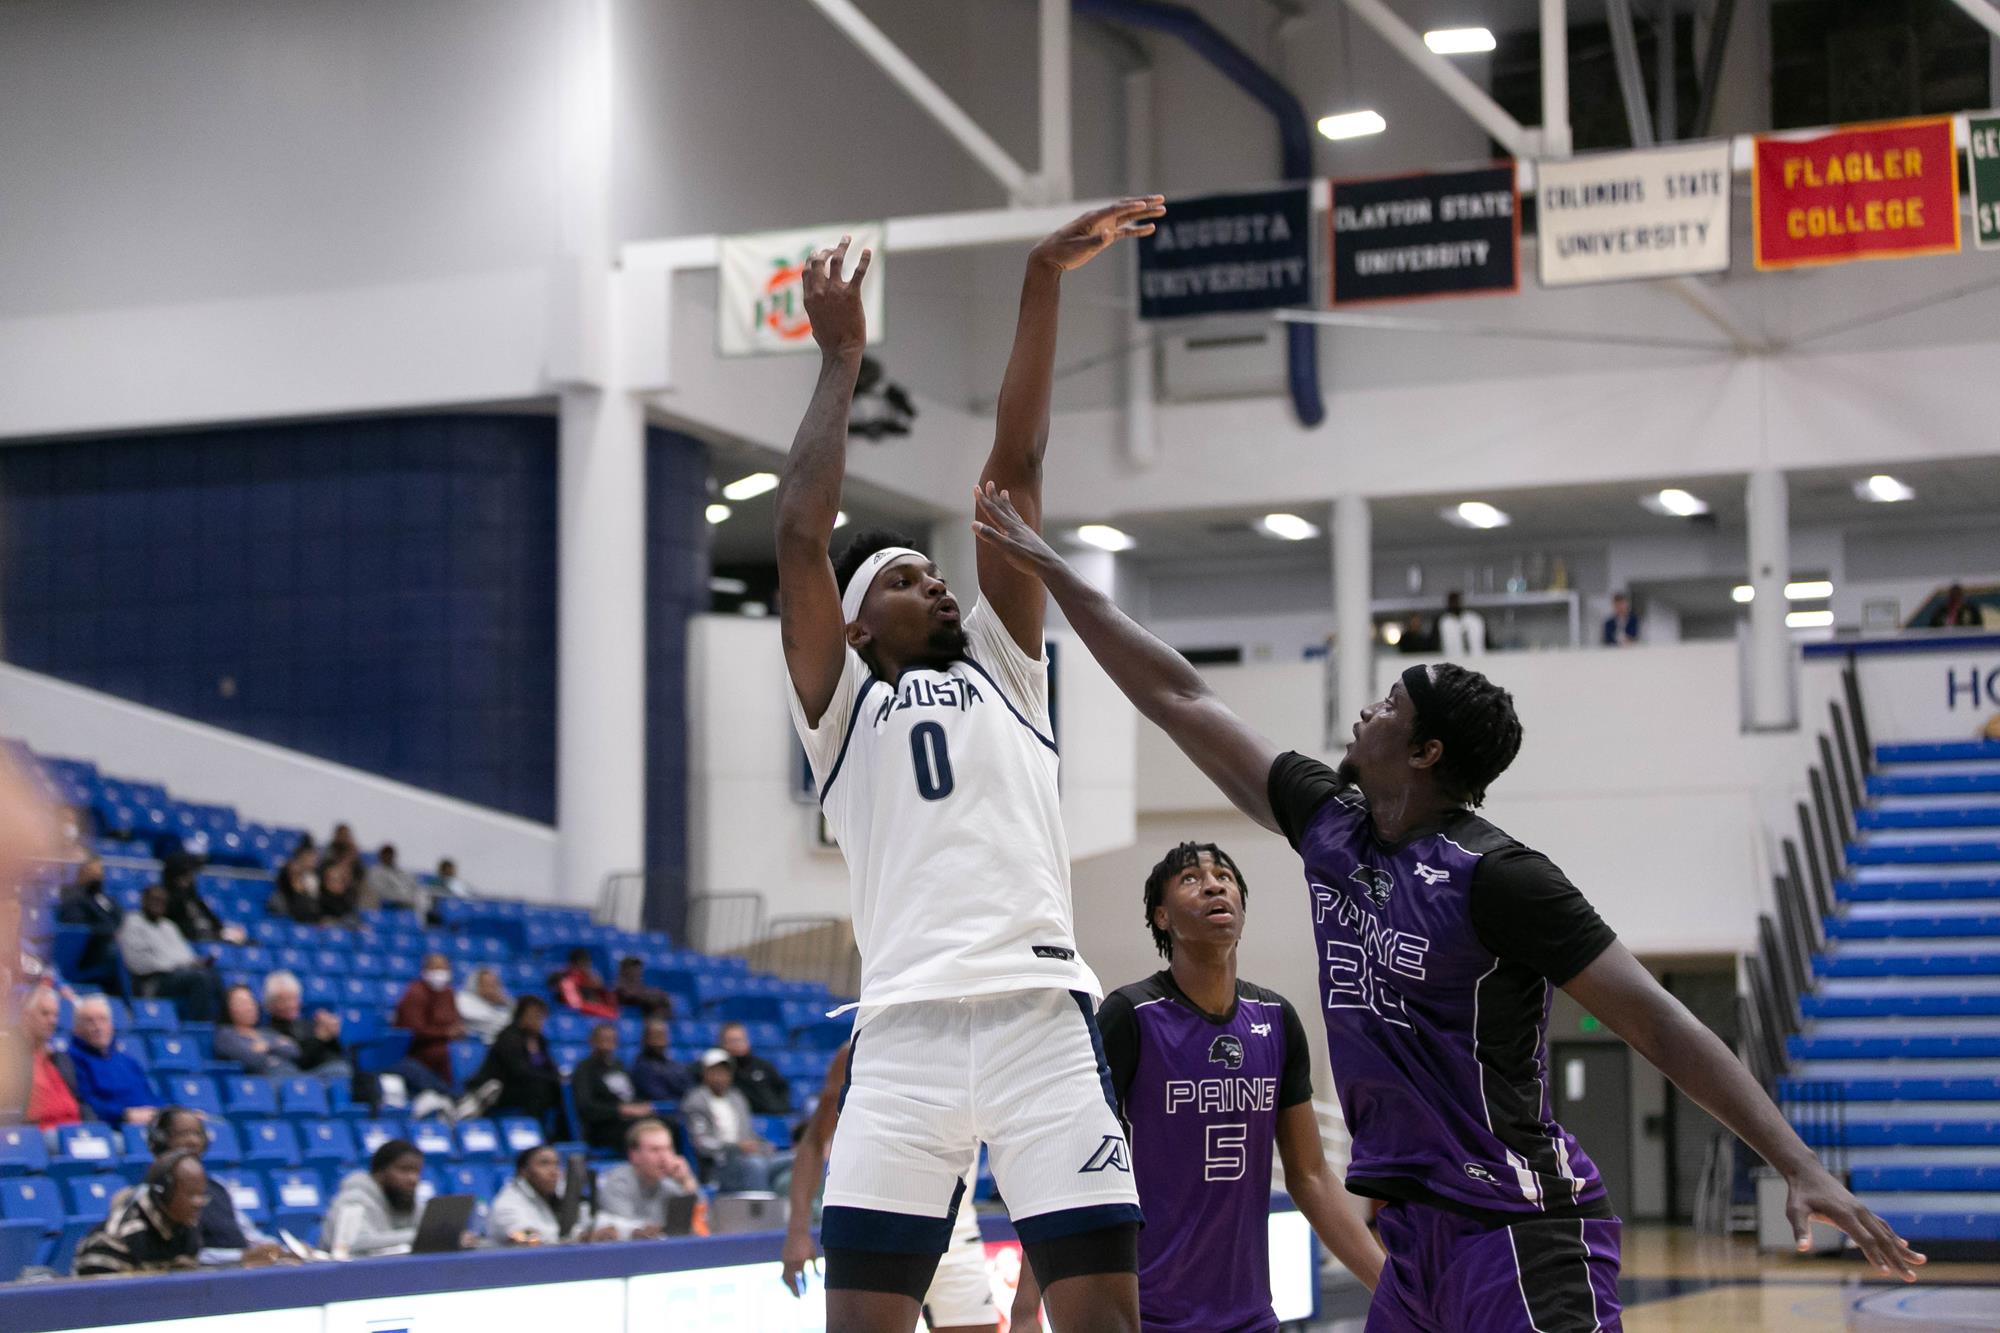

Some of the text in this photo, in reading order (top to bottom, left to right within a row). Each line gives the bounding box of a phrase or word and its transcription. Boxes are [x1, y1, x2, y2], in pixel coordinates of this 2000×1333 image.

[1784, 148, 1923, 188] FLAGLER
[1335, 190, 1513, 231] CLAYTON STATE
[1545, 171, 1723, 211] COLUMBUS STATE
[1154, 213, 1290, 251] AUGUSTA
[1556, 219, 1711, 258] UNIVERSITY
[1787, 198, 1925, 239] COLLEGE
[1143, 256, 1303, 298] UNIVERSITY
[1355, 240, 1490, 276] UNIVERSITY
[909, 720, 955, 802] 0
[1166, 1077, 1277, 1115] PAINE
[1204, 1123, 1247, 1182] 5
